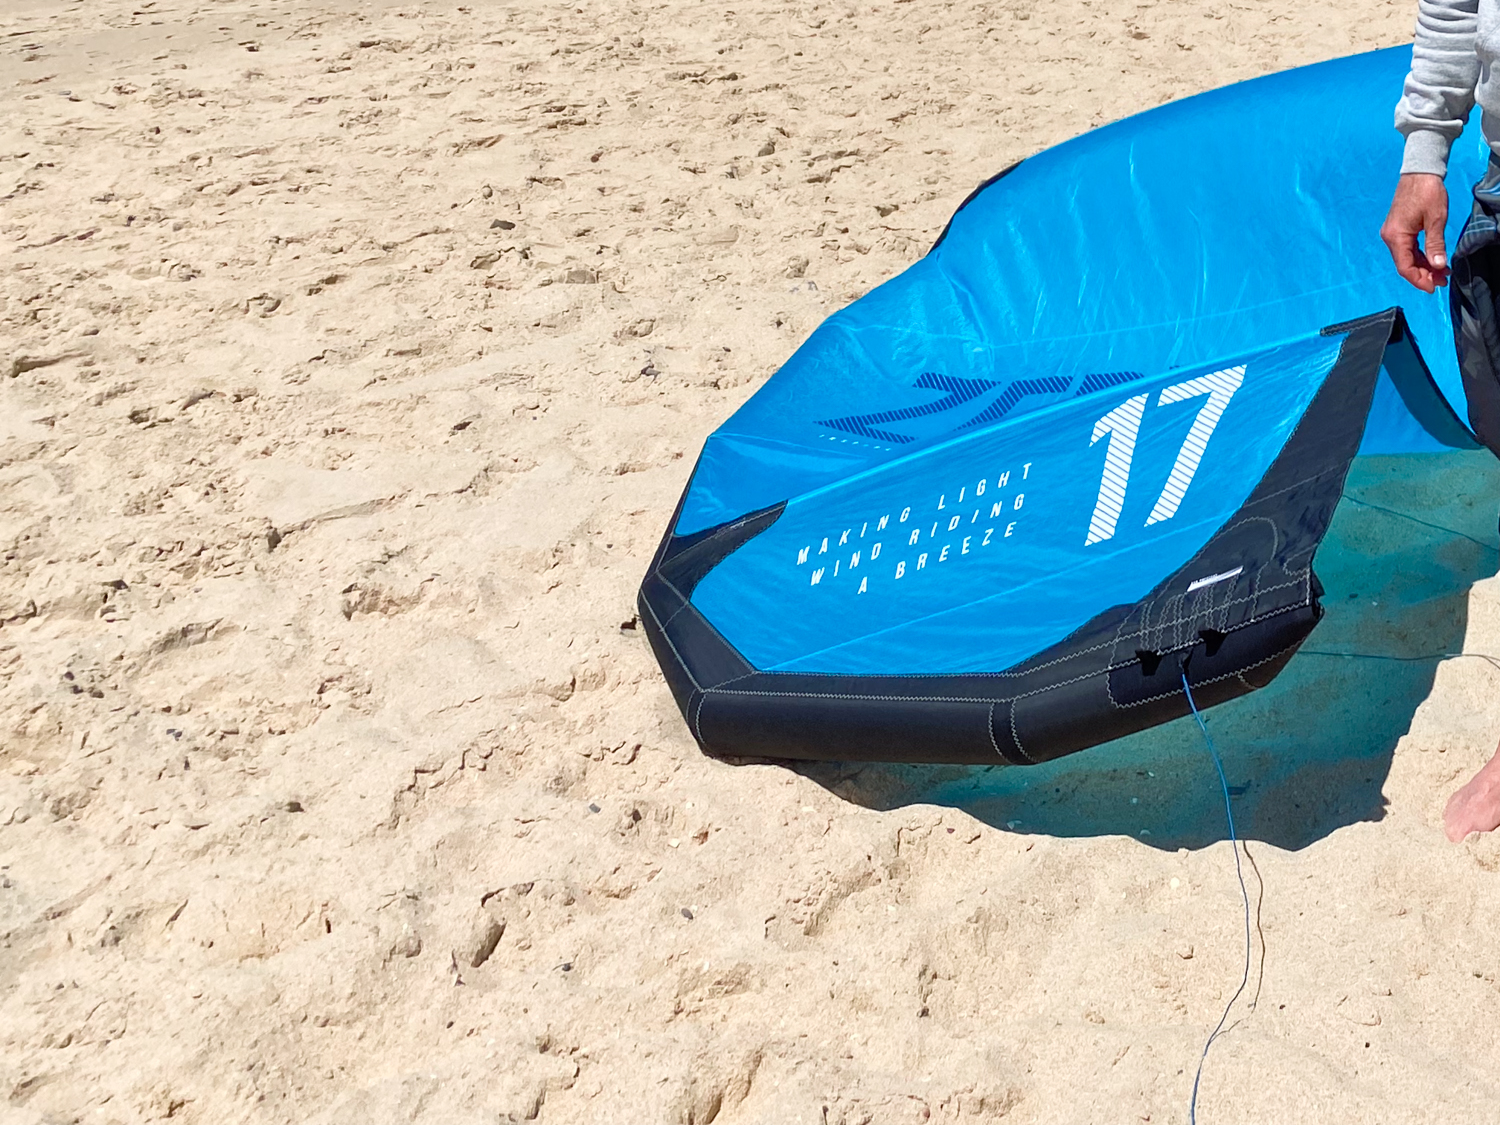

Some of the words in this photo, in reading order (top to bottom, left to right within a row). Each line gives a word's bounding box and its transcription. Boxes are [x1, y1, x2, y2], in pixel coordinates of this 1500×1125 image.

[1084, 363, 1248, 547] 17
[796, 506, 911, 566] MAKING
[937, 462, 1032, 510] LIGHT
[810, 542, 882, 586] WIND
[908, 493, 1025, 546] RIDING
[857, 576, 868, 595] A
[894, 521, 1017, 580] BREEZE
